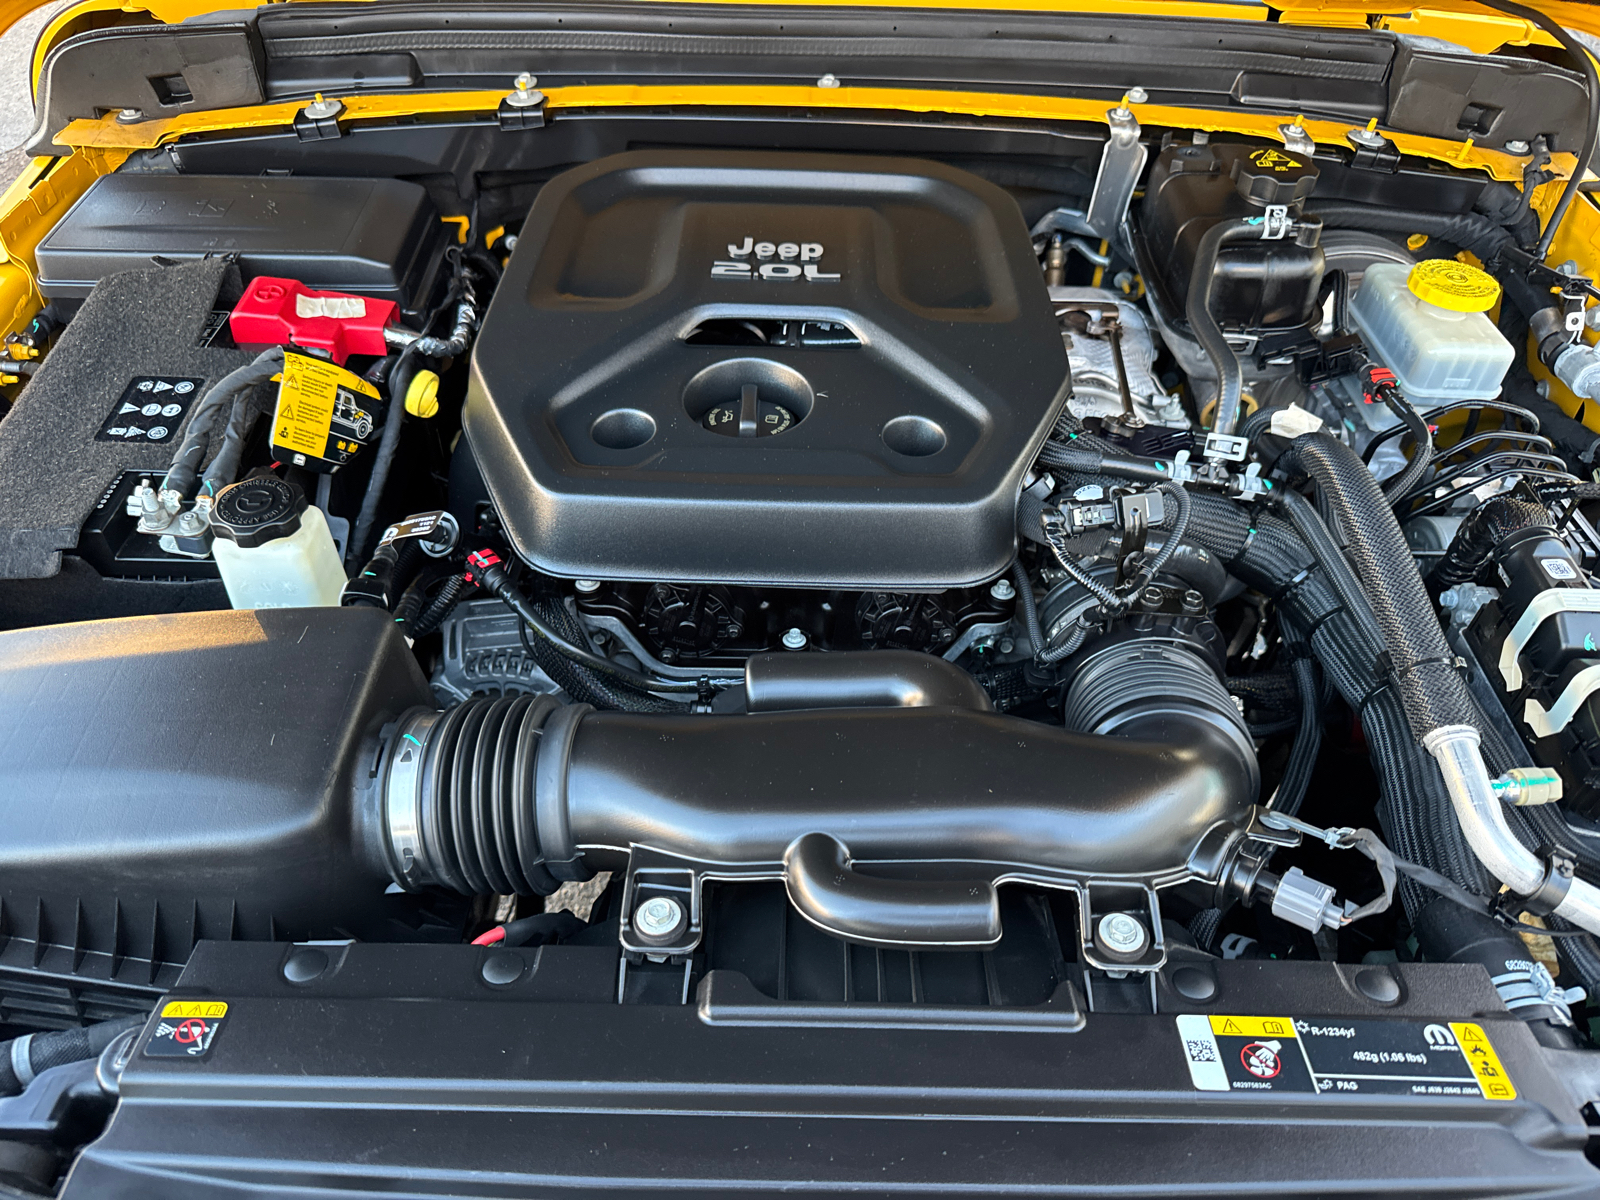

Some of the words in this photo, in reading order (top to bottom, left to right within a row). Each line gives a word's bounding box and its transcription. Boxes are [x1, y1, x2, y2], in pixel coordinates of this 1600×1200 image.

[727, 236, 825, 262] Jeep
[710, 260, 841, 281] 2.0L
[1311, 1026, 1355, 1038] R-1234yf
[1353, 1051, 1379, 1063] 482g
[1379, 1051, 1405, 1063] (1.06
[1405, 1053, 1427, 1065] lbs)
[1337, 1081, 1358, 1090] PAG
